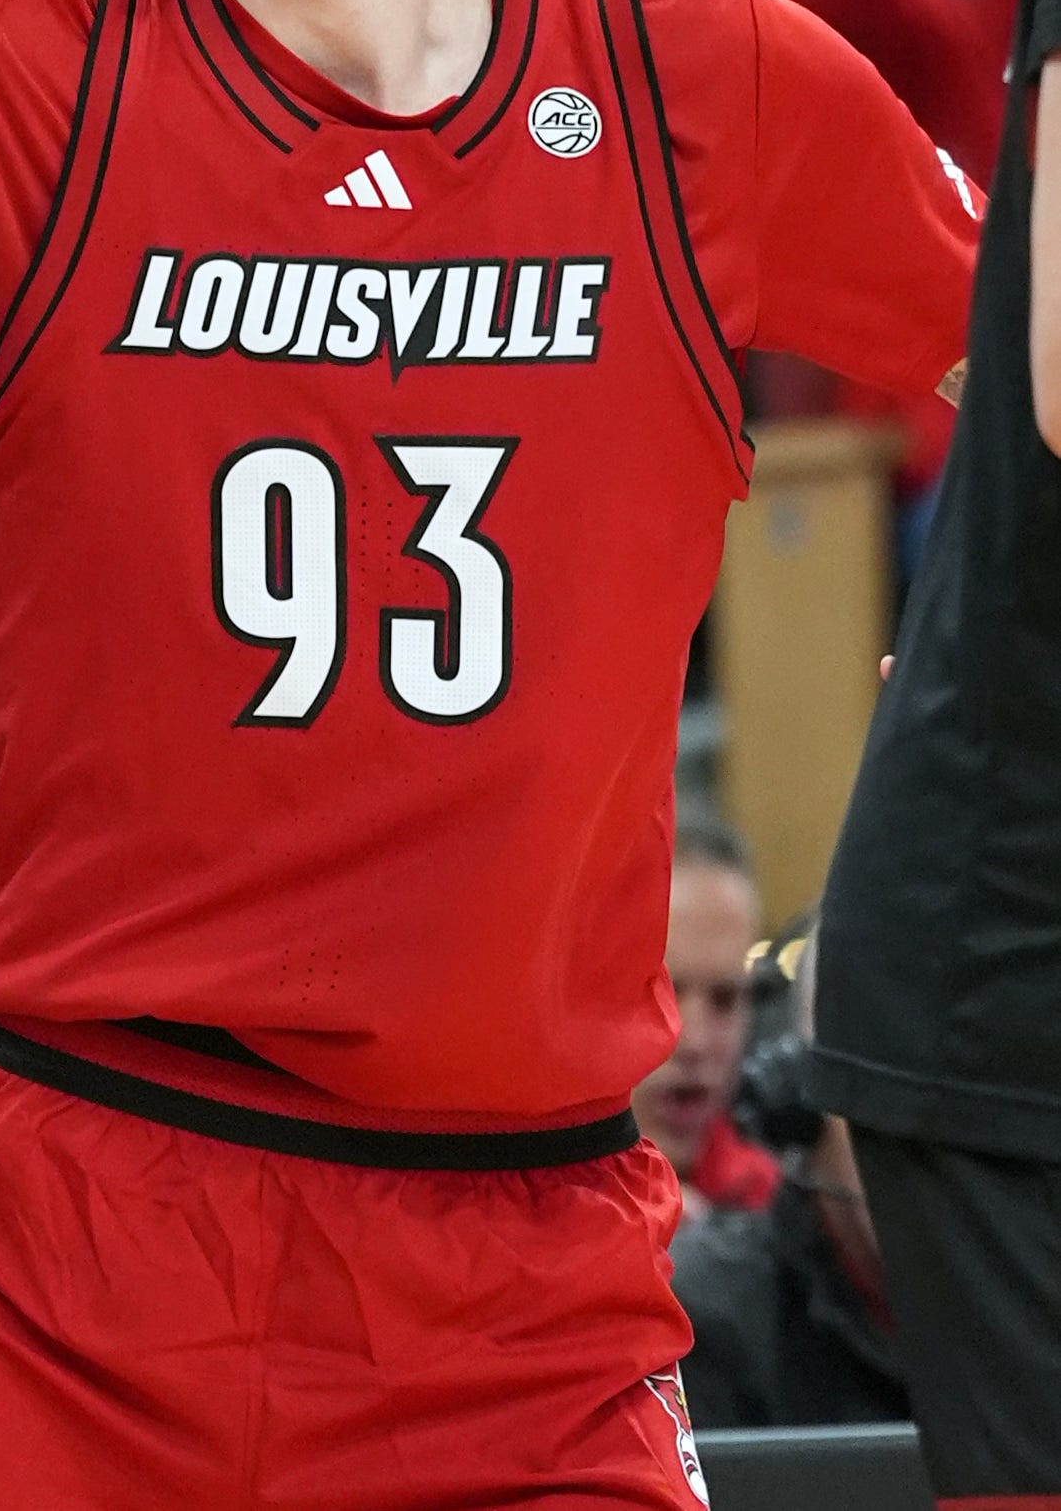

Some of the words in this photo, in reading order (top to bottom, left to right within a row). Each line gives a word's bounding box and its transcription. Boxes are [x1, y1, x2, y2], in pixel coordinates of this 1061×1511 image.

[540, 111, 593, 126] ACC
[109, 249, 610, 371] LOUISVILLE
[210, 434, 521, 729] 93
